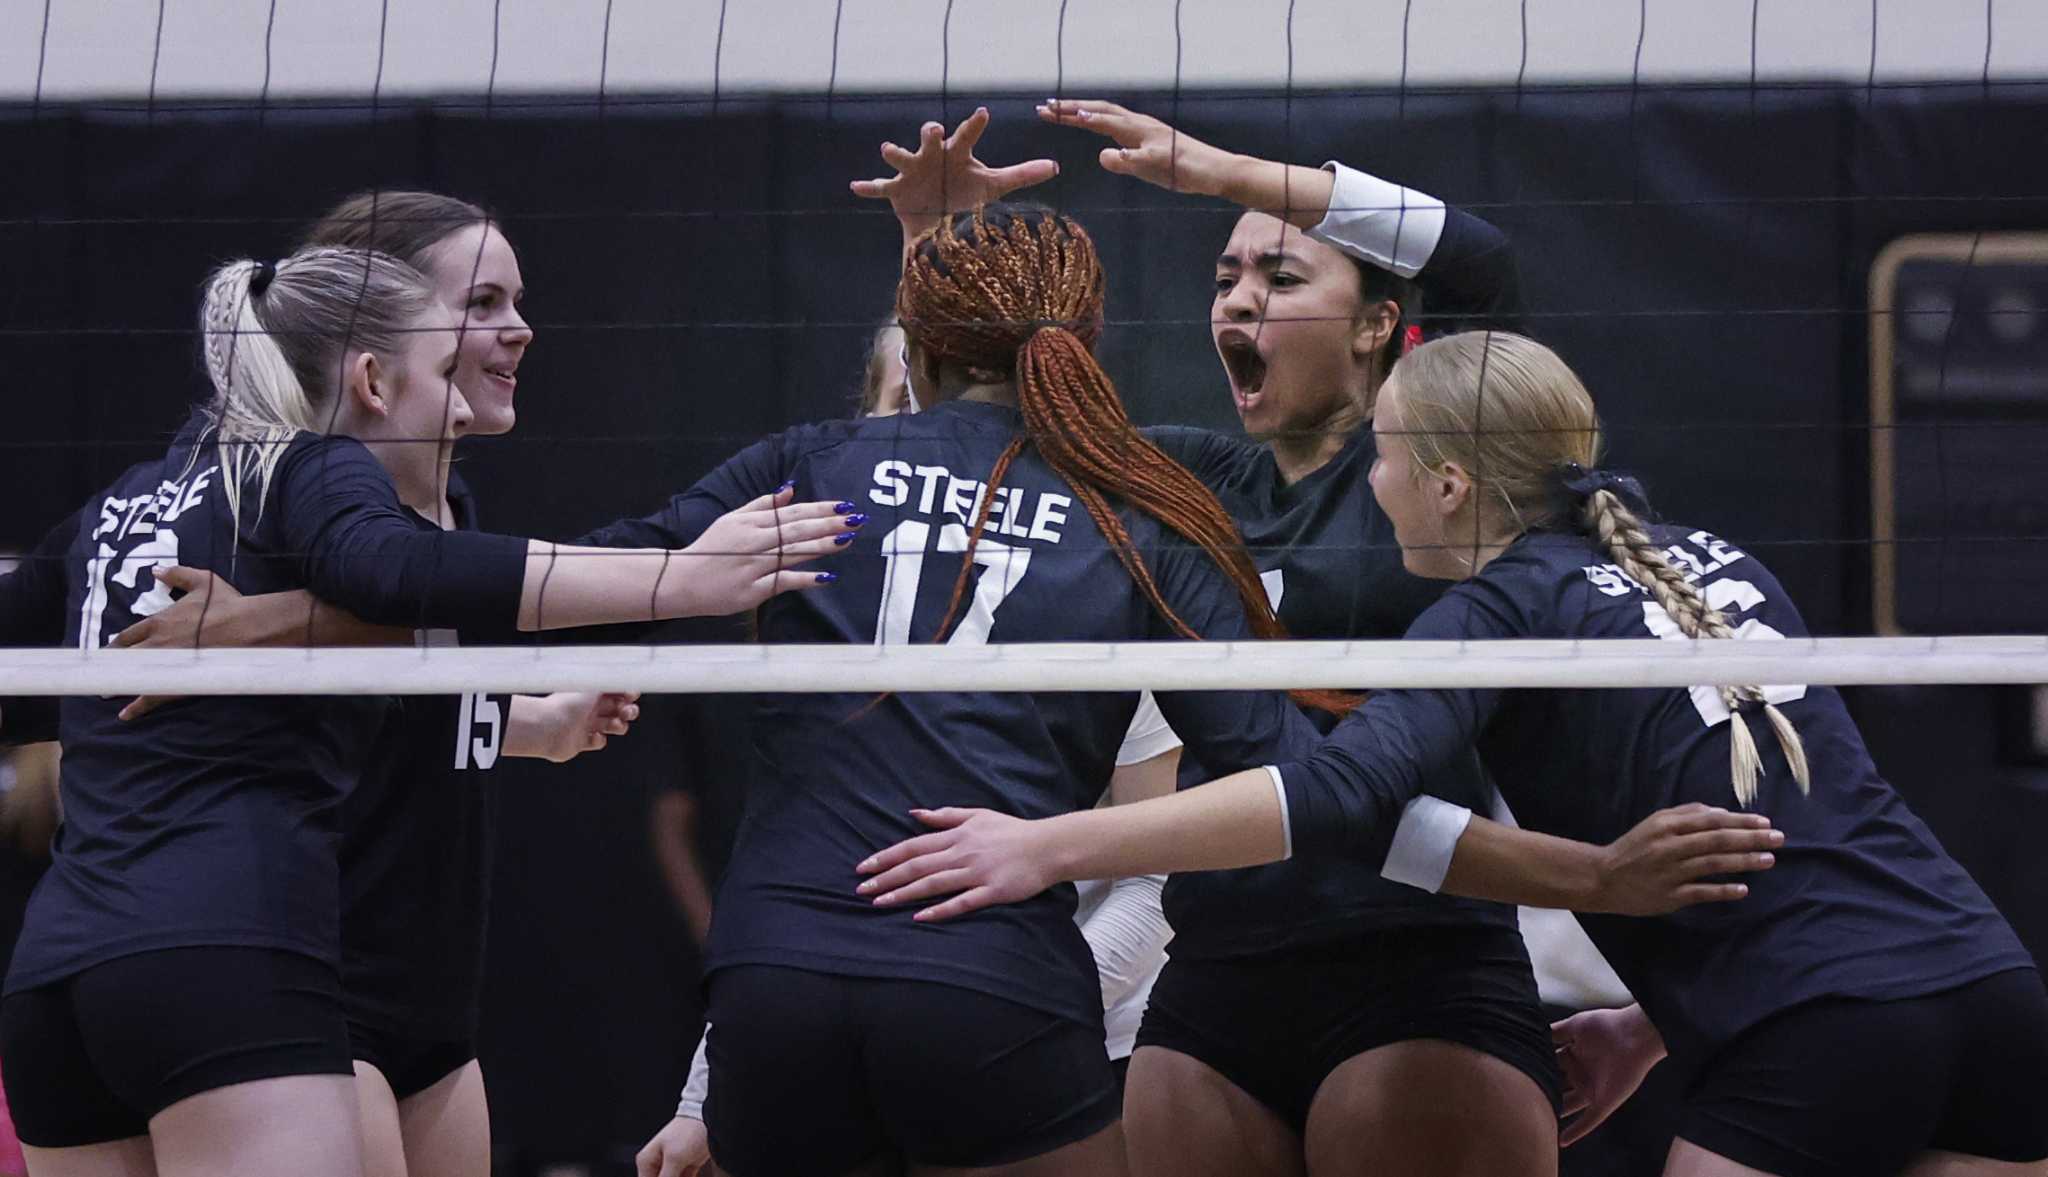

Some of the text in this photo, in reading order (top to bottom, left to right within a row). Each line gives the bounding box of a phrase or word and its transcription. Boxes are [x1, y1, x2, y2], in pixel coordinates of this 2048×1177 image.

[92, 465, 219, 541] STEELE
[868, 460, 1072, 544] STEELE
[874, 519, 1032, 646] 17
[1582, 530, 1746, 597] STLE
[454, 691, 501, 770] 15
